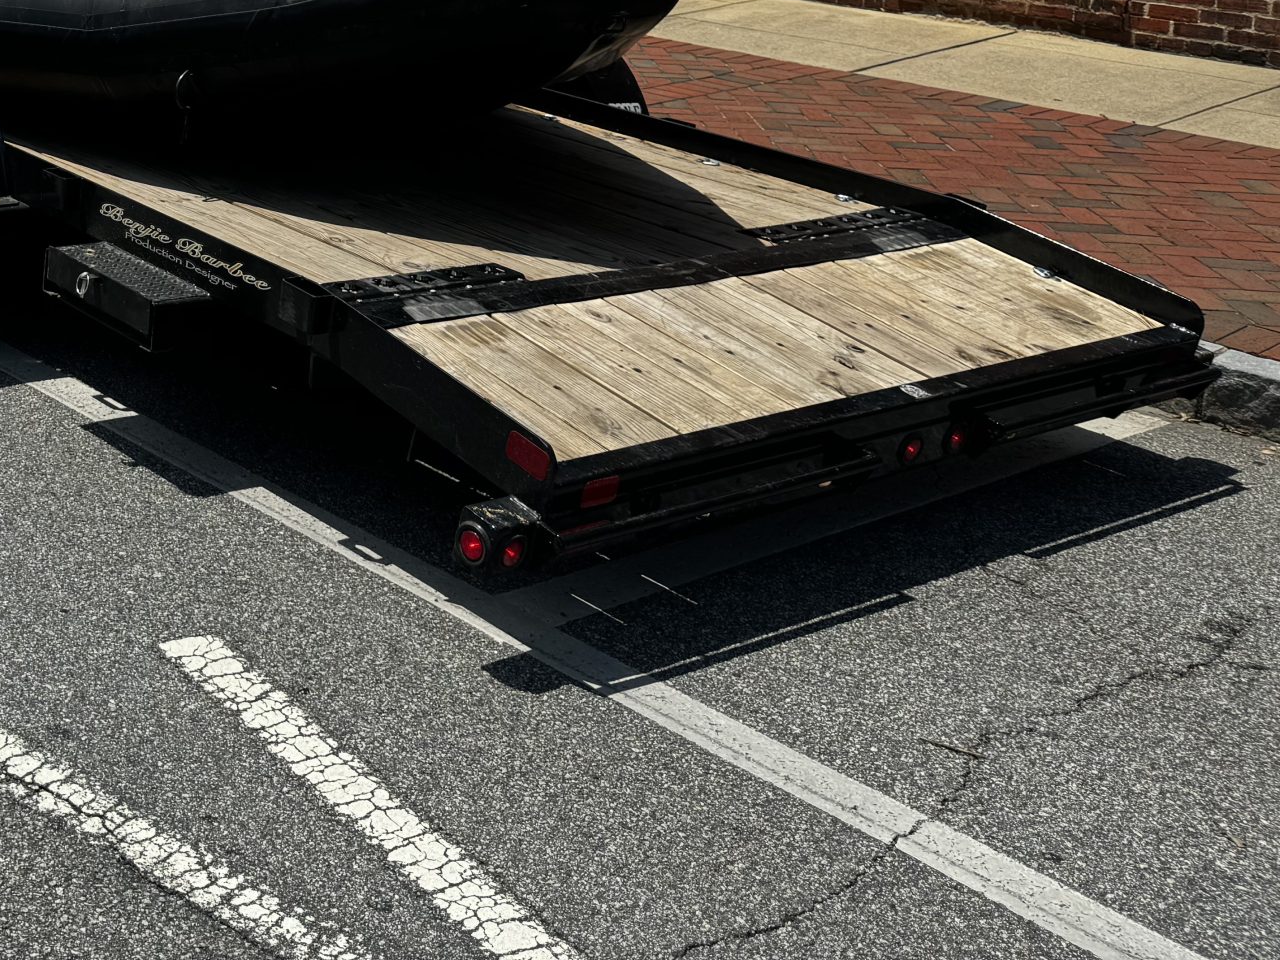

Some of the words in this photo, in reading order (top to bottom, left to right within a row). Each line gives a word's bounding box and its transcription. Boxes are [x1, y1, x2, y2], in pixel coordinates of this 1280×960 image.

[99, 202, 173, 244] Benjie
[175, 237, 272, 291] Barbee
[124, 231, 183, 265] Production
[185, 259, 238, 291] Designer
